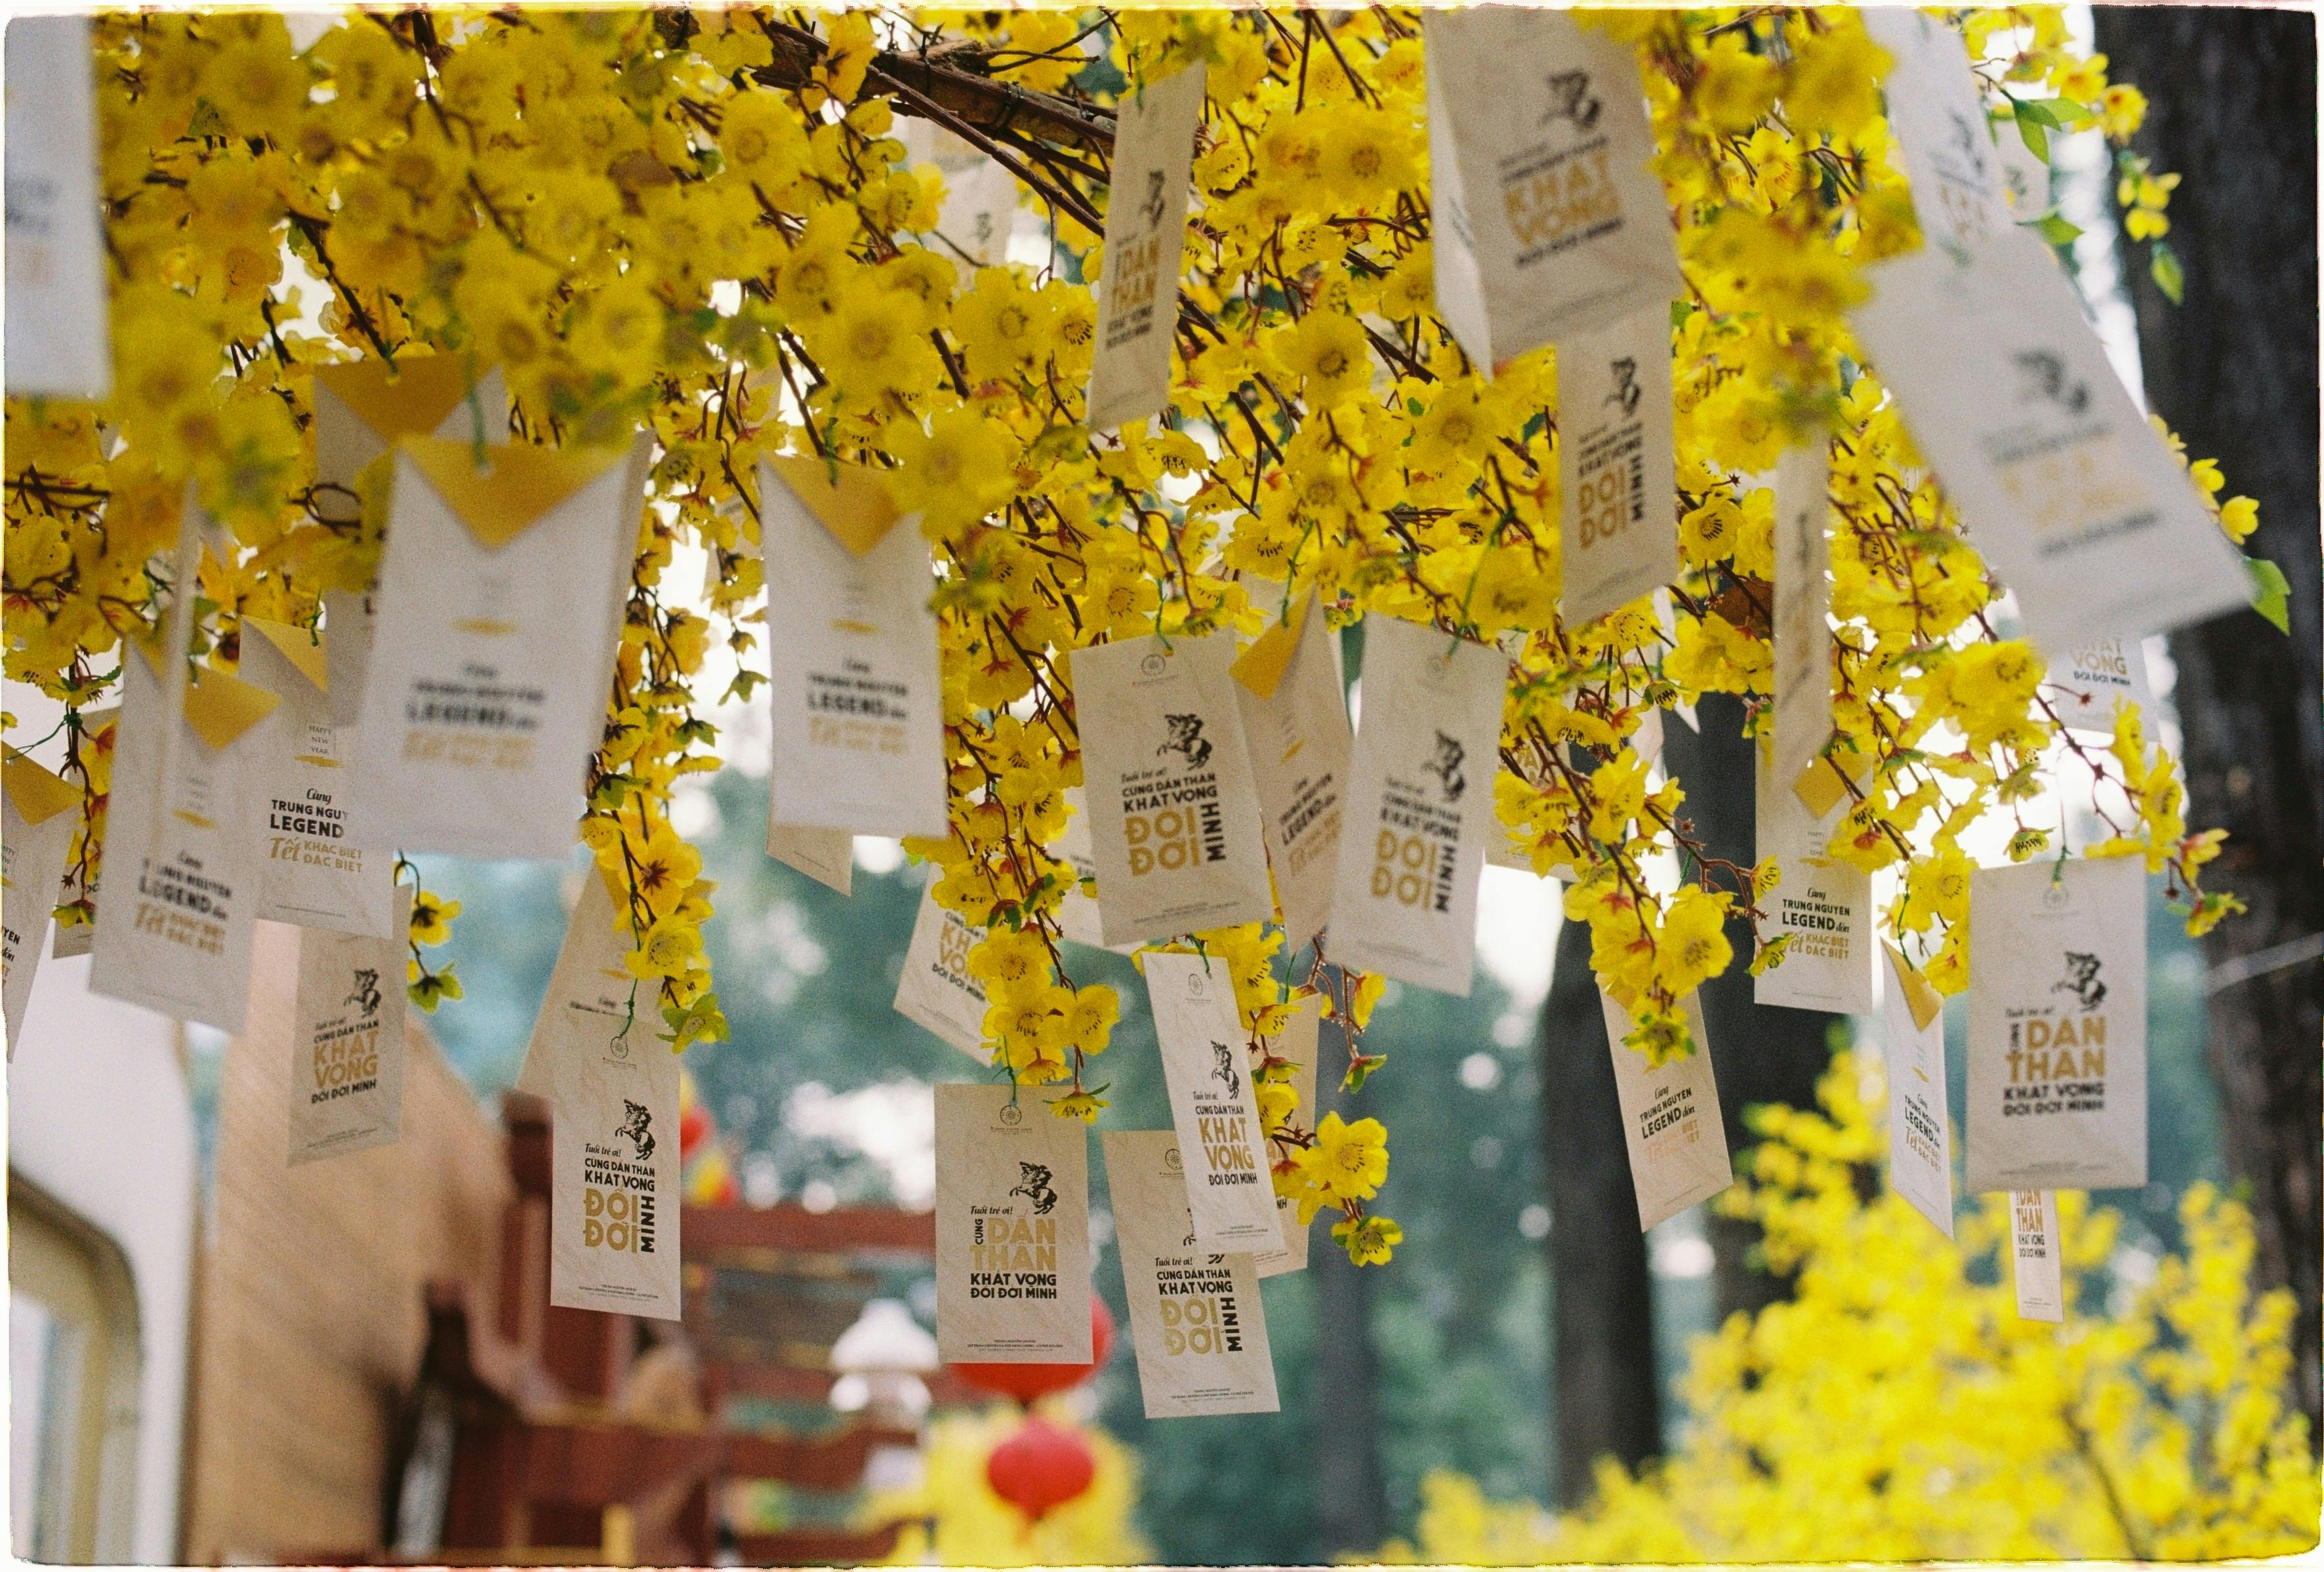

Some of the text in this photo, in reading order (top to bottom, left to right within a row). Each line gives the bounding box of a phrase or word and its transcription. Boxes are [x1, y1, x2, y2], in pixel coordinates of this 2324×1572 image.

[272, 799, 313, 815] TRUNG
[270, 813, 344, 838] LEGEND
[1783, 899, 1812, 911] TRUNG
[1782, 912, 1835, 930] LEGEND
[1639, 1104, 1662, 1123] TRUNG
[1642, 1107, 1681, 1139] LEGEND
[1905, 1106, 1934, 1142] LEGEND
